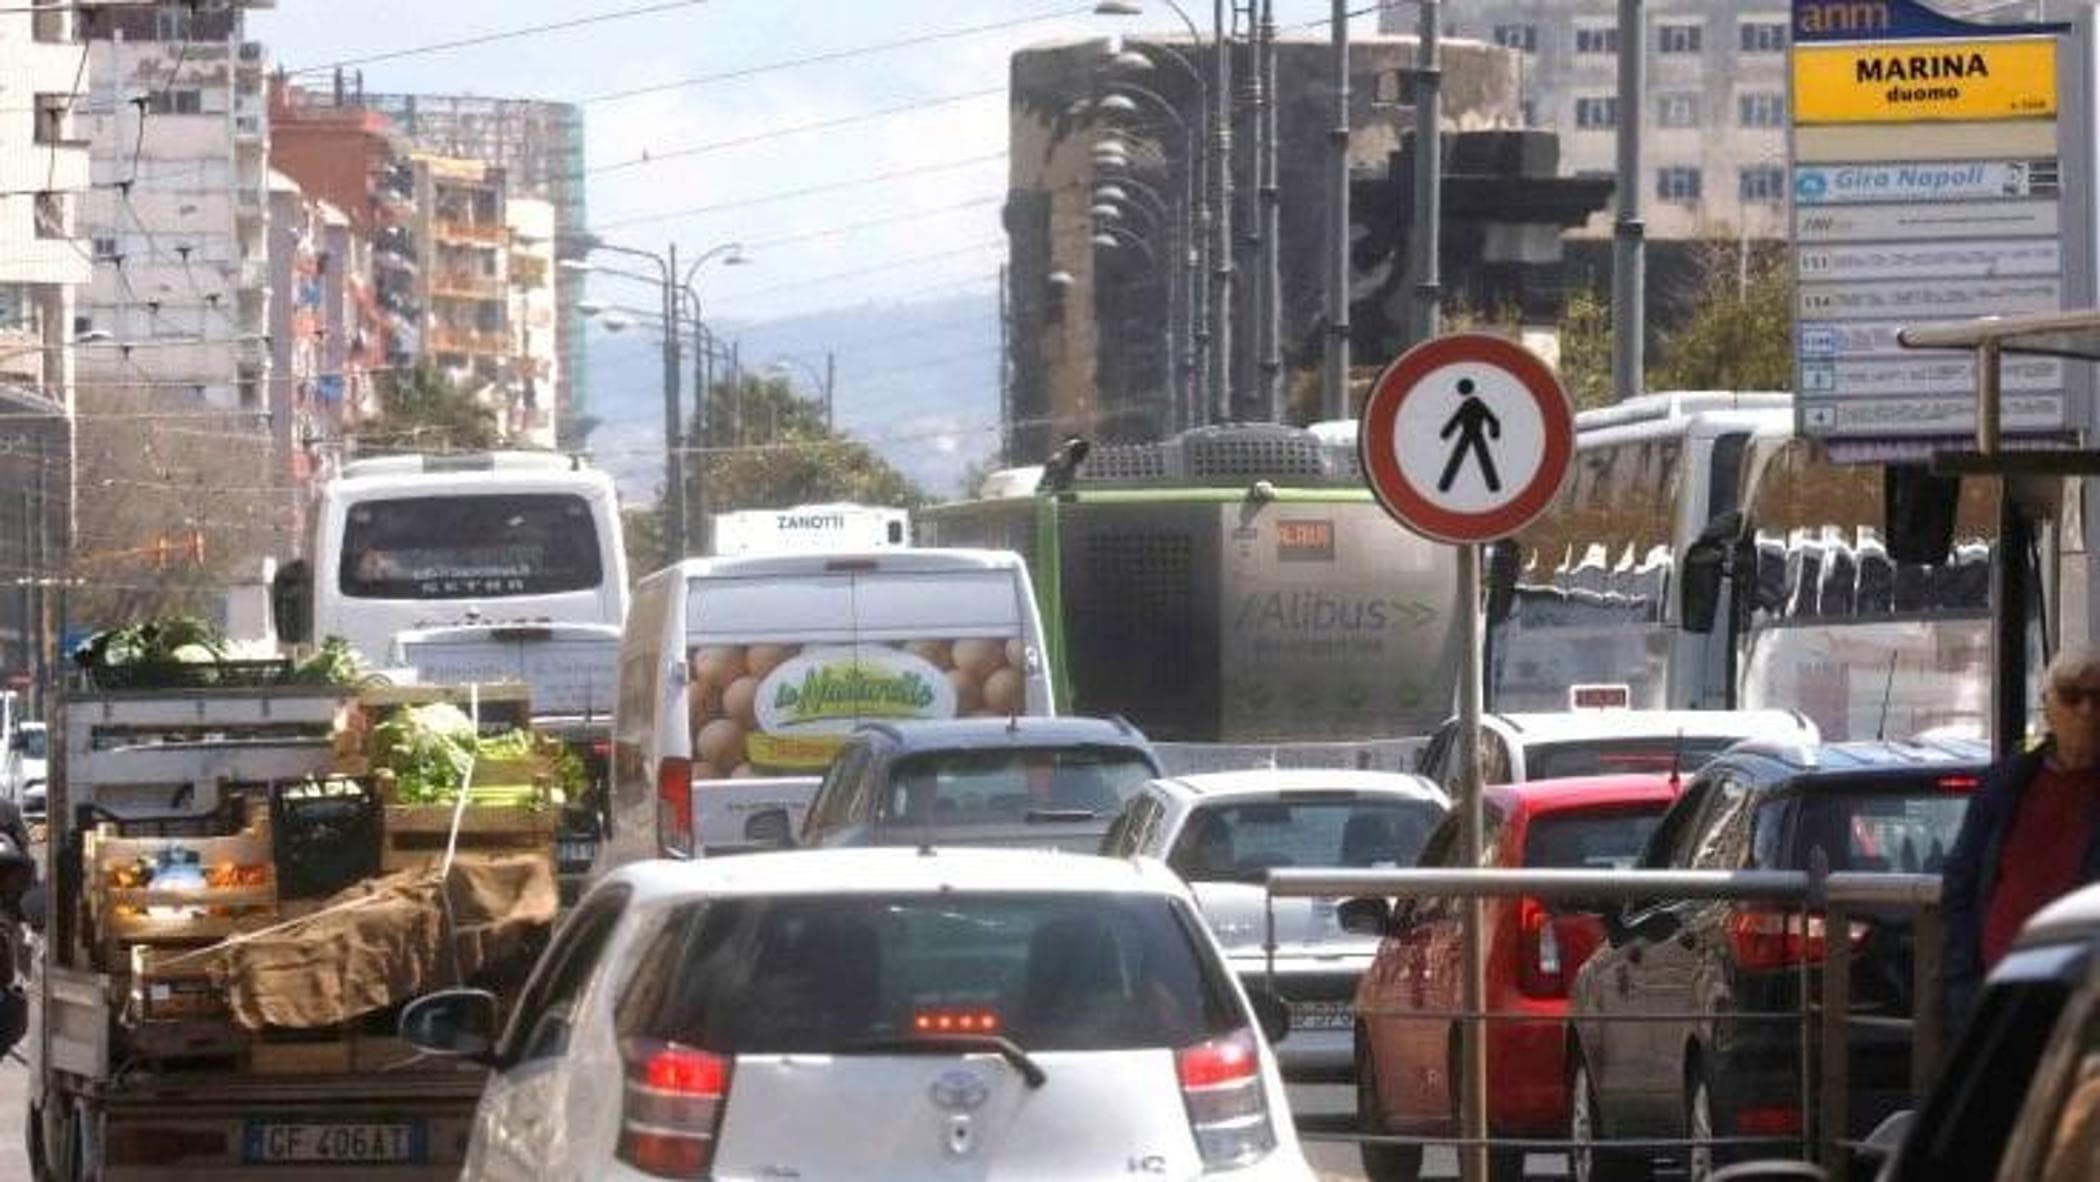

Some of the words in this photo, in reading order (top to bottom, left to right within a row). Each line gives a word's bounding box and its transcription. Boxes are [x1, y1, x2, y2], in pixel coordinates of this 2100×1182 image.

[1801, 4, 1887, 32] anm
[1857, 54, 1988, 83] MARINA
[1886, 86, 1959, 103] duomo
[1898, 164, 1985, 188] Napoli
[776, 515, 844, 530] ZANOTTI
